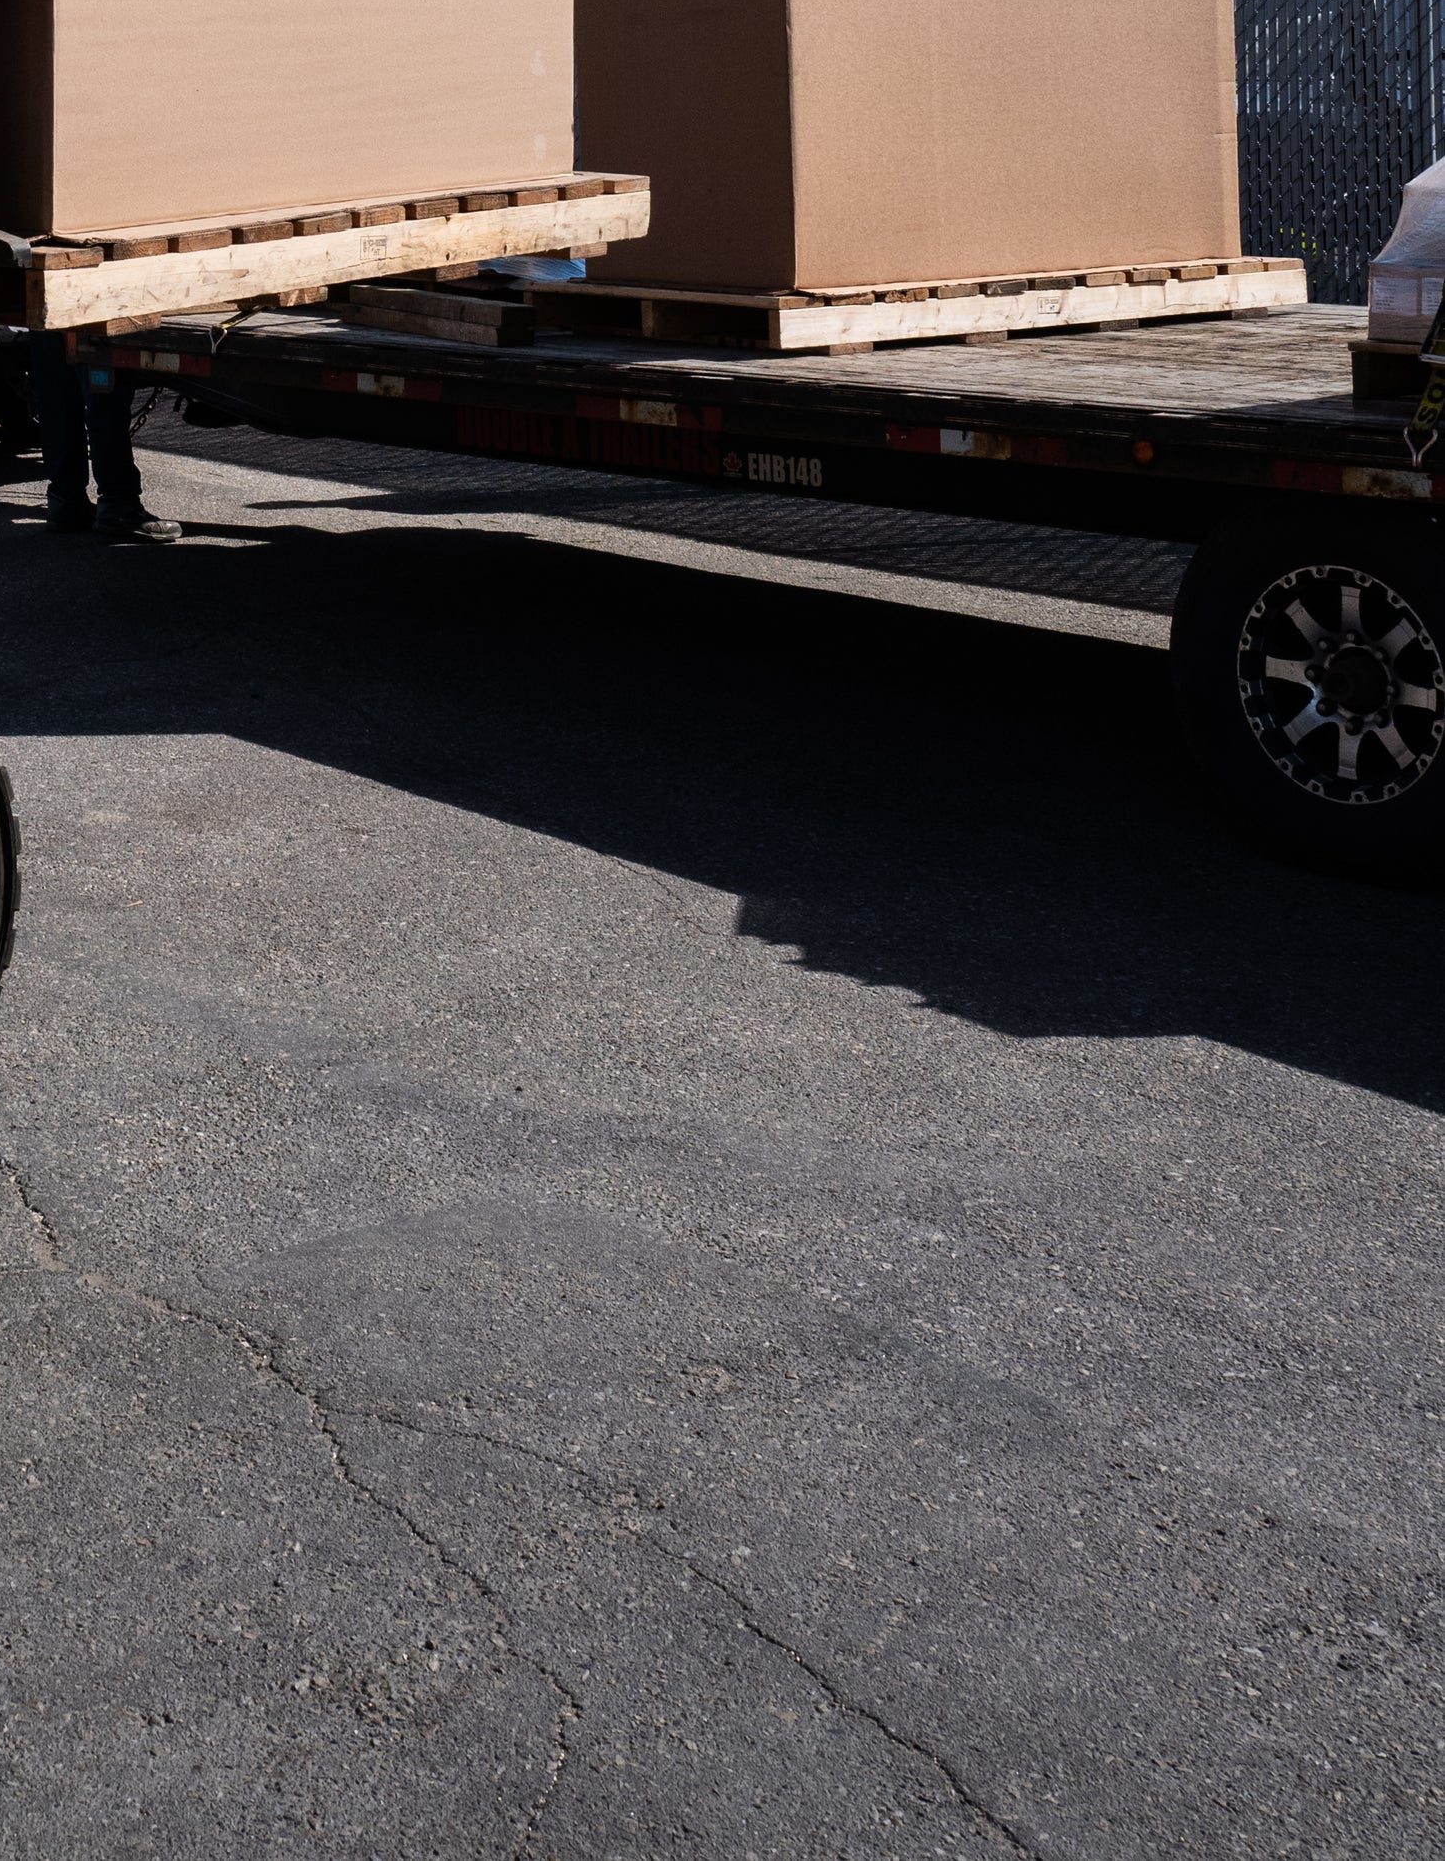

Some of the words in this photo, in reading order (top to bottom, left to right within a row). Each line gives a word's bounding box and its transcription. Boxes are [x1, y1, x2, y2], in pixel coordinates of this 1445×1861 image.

[454, 404, 555, 458] DOUBLE
[587, 422, 723, 477] TRAILERS
[747, 453, 823, 488] EHB148
